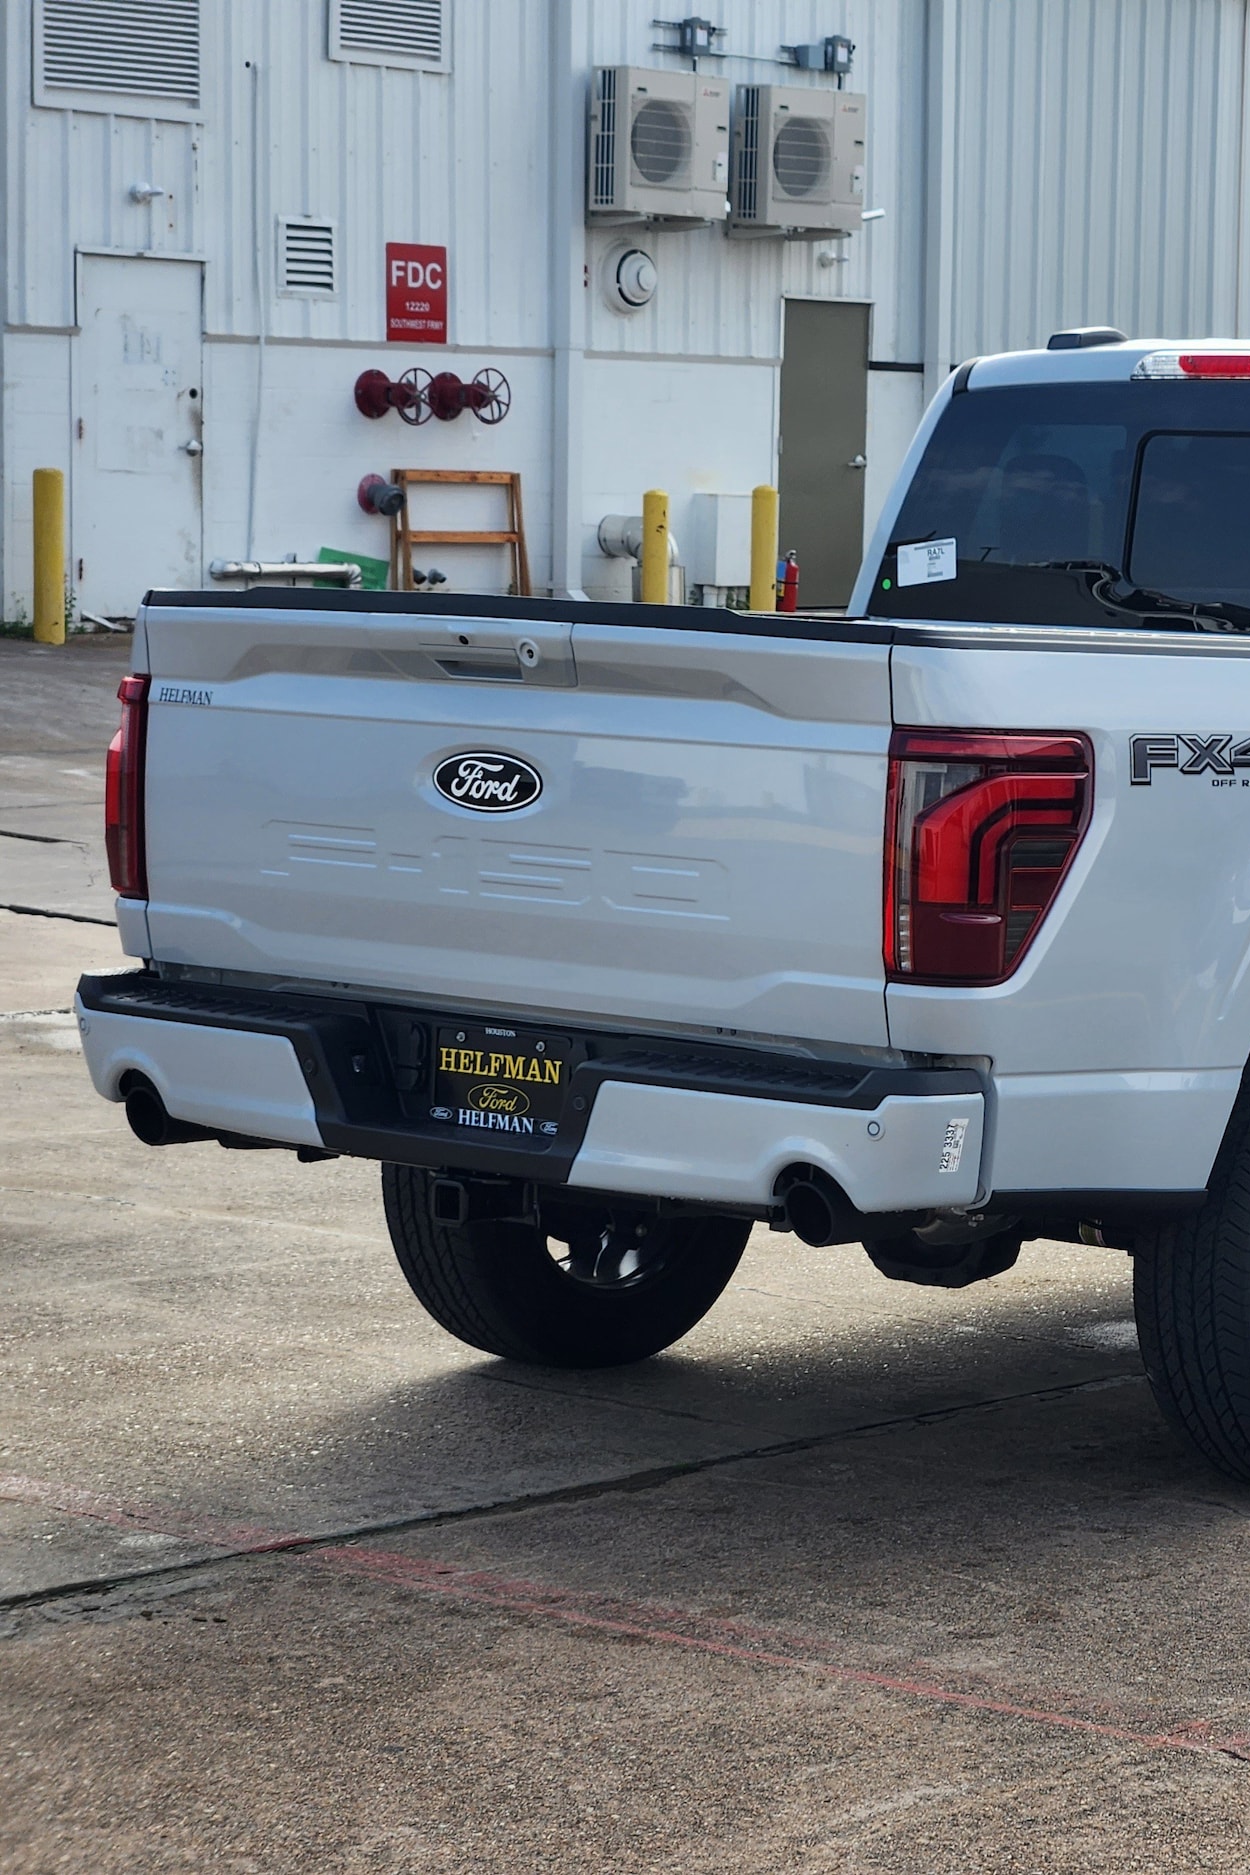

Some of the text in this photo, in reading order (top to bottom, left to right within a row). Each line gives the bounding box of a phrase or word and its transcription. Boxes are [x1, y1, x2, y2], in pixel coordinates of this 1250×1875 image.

[391, 260, 442, 290] FDC
[405, 301, 430, 312] 12220
[390, 318, 426, 330] SOUTHWEST
[159, 687, 214, 706] HELFMAN
[451, 759, 521, 802] Ford
[1211, 779, 1237, 787] OFF
[485, 1026, 517, 1037] HOUSTON
[439, 1047, 562, 1084] HELFMAN
[478, 1086, 518, 1112] Ford
[458, 1108, 534, 1134] HELFMAN
[940, 1124, 957, 1170] 225 3337
